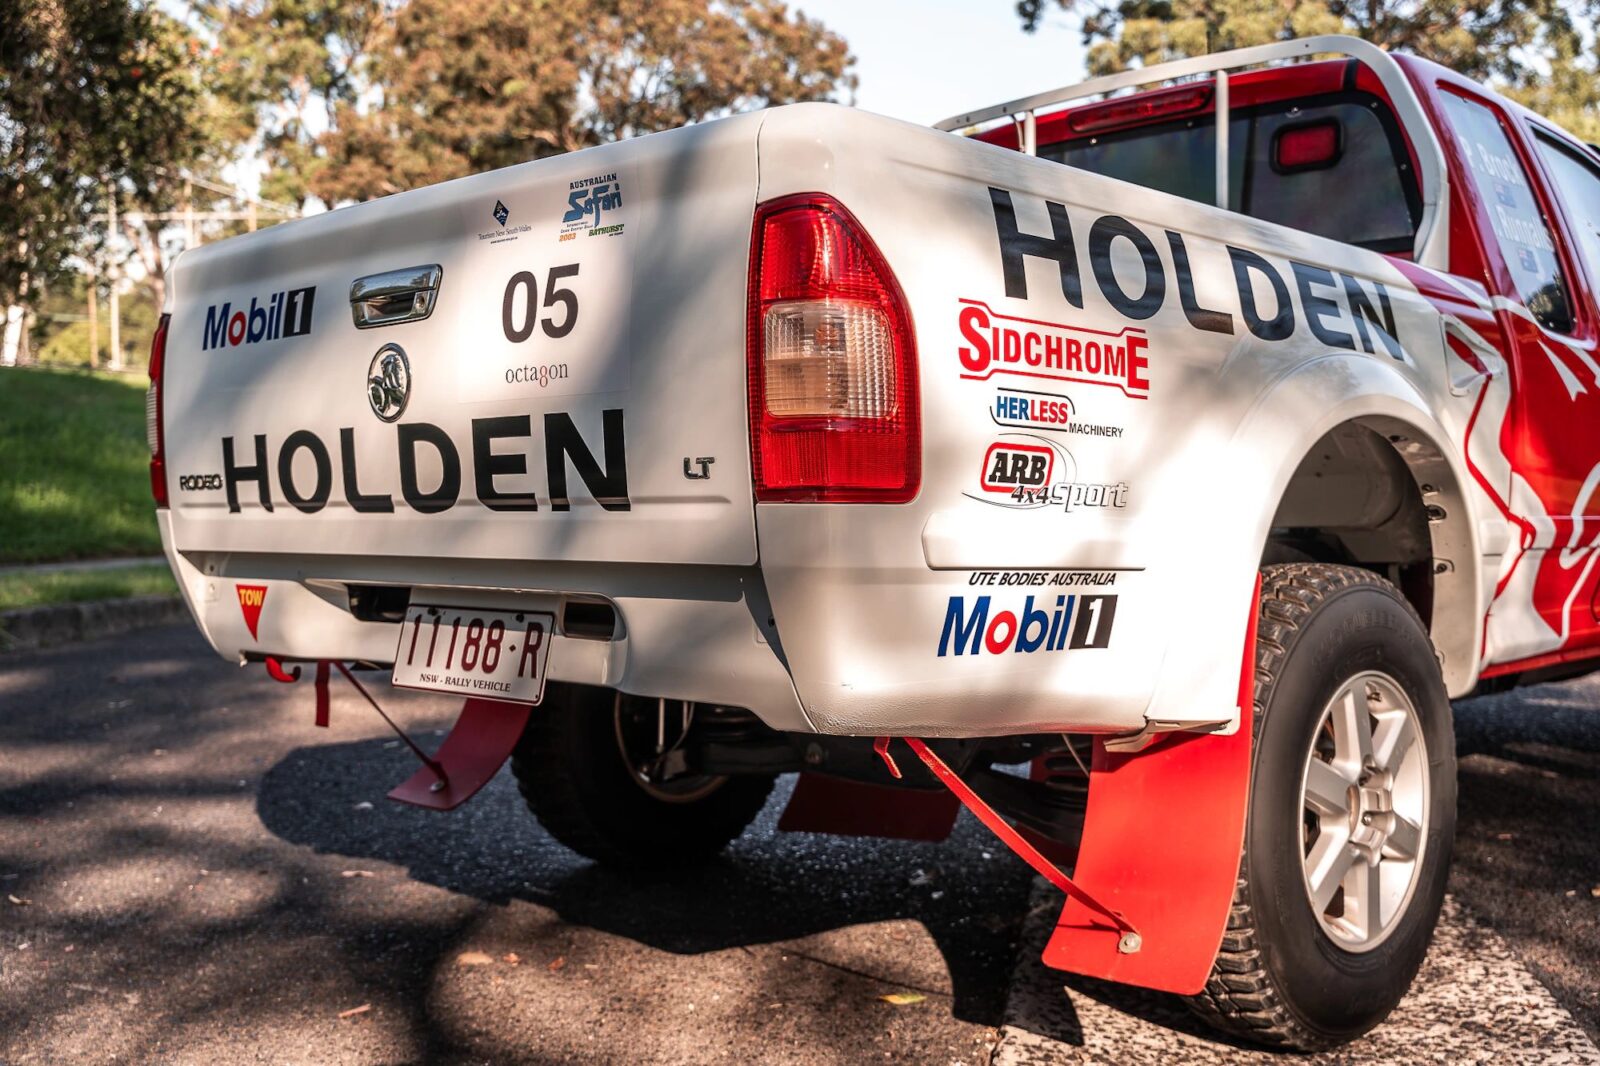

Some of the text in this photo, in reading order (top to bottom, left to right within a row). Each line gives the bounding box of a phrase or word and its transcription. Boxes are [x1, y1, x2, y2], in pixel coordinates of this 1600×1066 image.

[569, 173, 617, 190] AUSTRALIAN
[495, 229, 506, 238] New
[506, 226, 519, 236] South
[518, 224, 532, 233] Wales
[559, 232, 577, 242] 2003
[588, 223, 625, 237] BATHURST
[987, 186, 1405, 361] HOLDEN
[502, 263, 580, 343] 05
[958, 306, 1150, 390] SIDCHROME
[996, 395, 1069, 424] HERLESS
[1068, 422, 1124, 438] MACHINERY
[222, 408, 631, 514] HOLDEN
[683, 456, 715, 480] LT
[988, 451, 1047, 486] ARB
[180, 474, 223, 491] RODEO
[1011, 481, 1129, 513] 4x4 sport
[968, 571, 1117, 586] UTE BODIES AUSTRALIA
[239, 589, 264, 606] TOW
[420, 673, 439, 683] NSW
[444, 675, 472, 688] RALLY
[473, 680, 512, 692] VEHICLE
